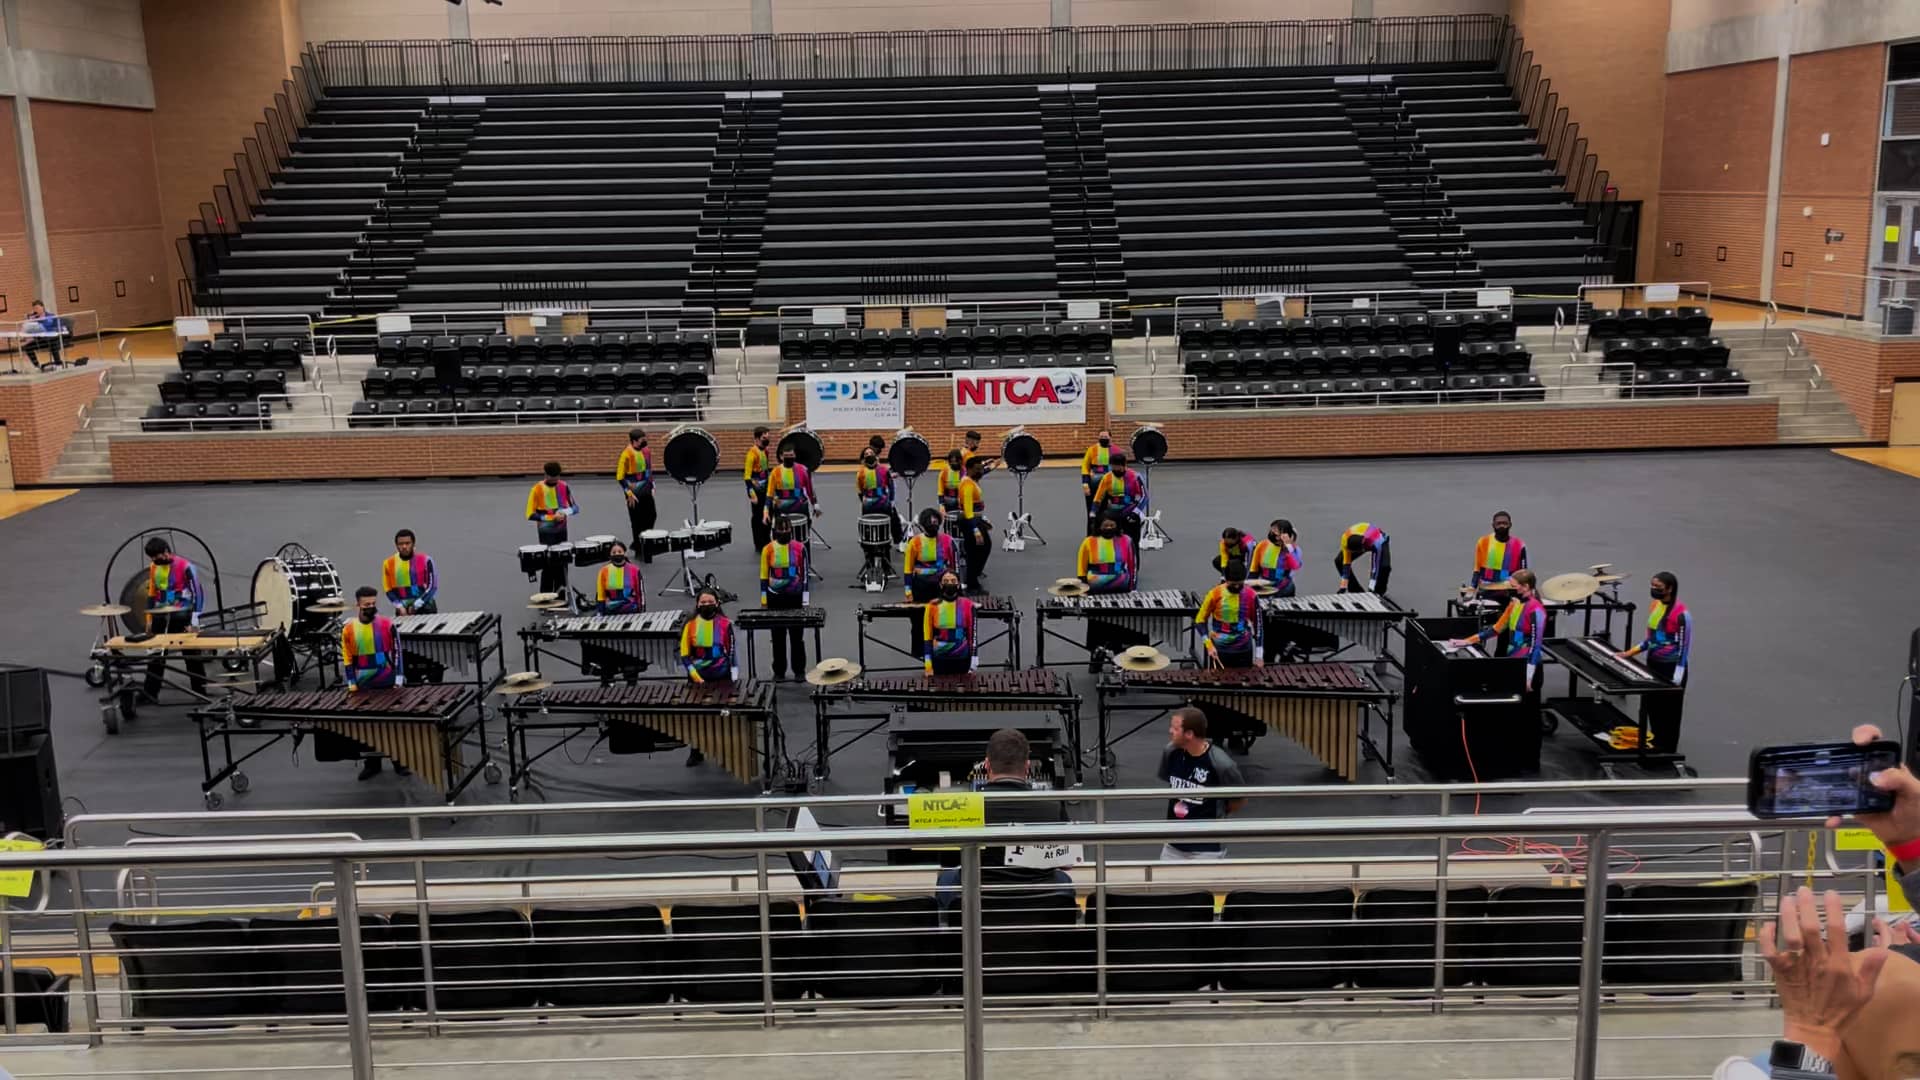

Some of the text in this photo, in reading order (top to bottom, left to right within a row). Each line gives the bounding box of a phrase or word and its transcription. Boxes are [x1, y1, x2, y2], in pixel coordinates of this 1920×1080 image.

[957, 376, 1060, 406] NTCA
[923, 799, 961, 812] NTCA
[1044, 851, 1054, 860] At
[1056, 845, 1070, 857] Rail
